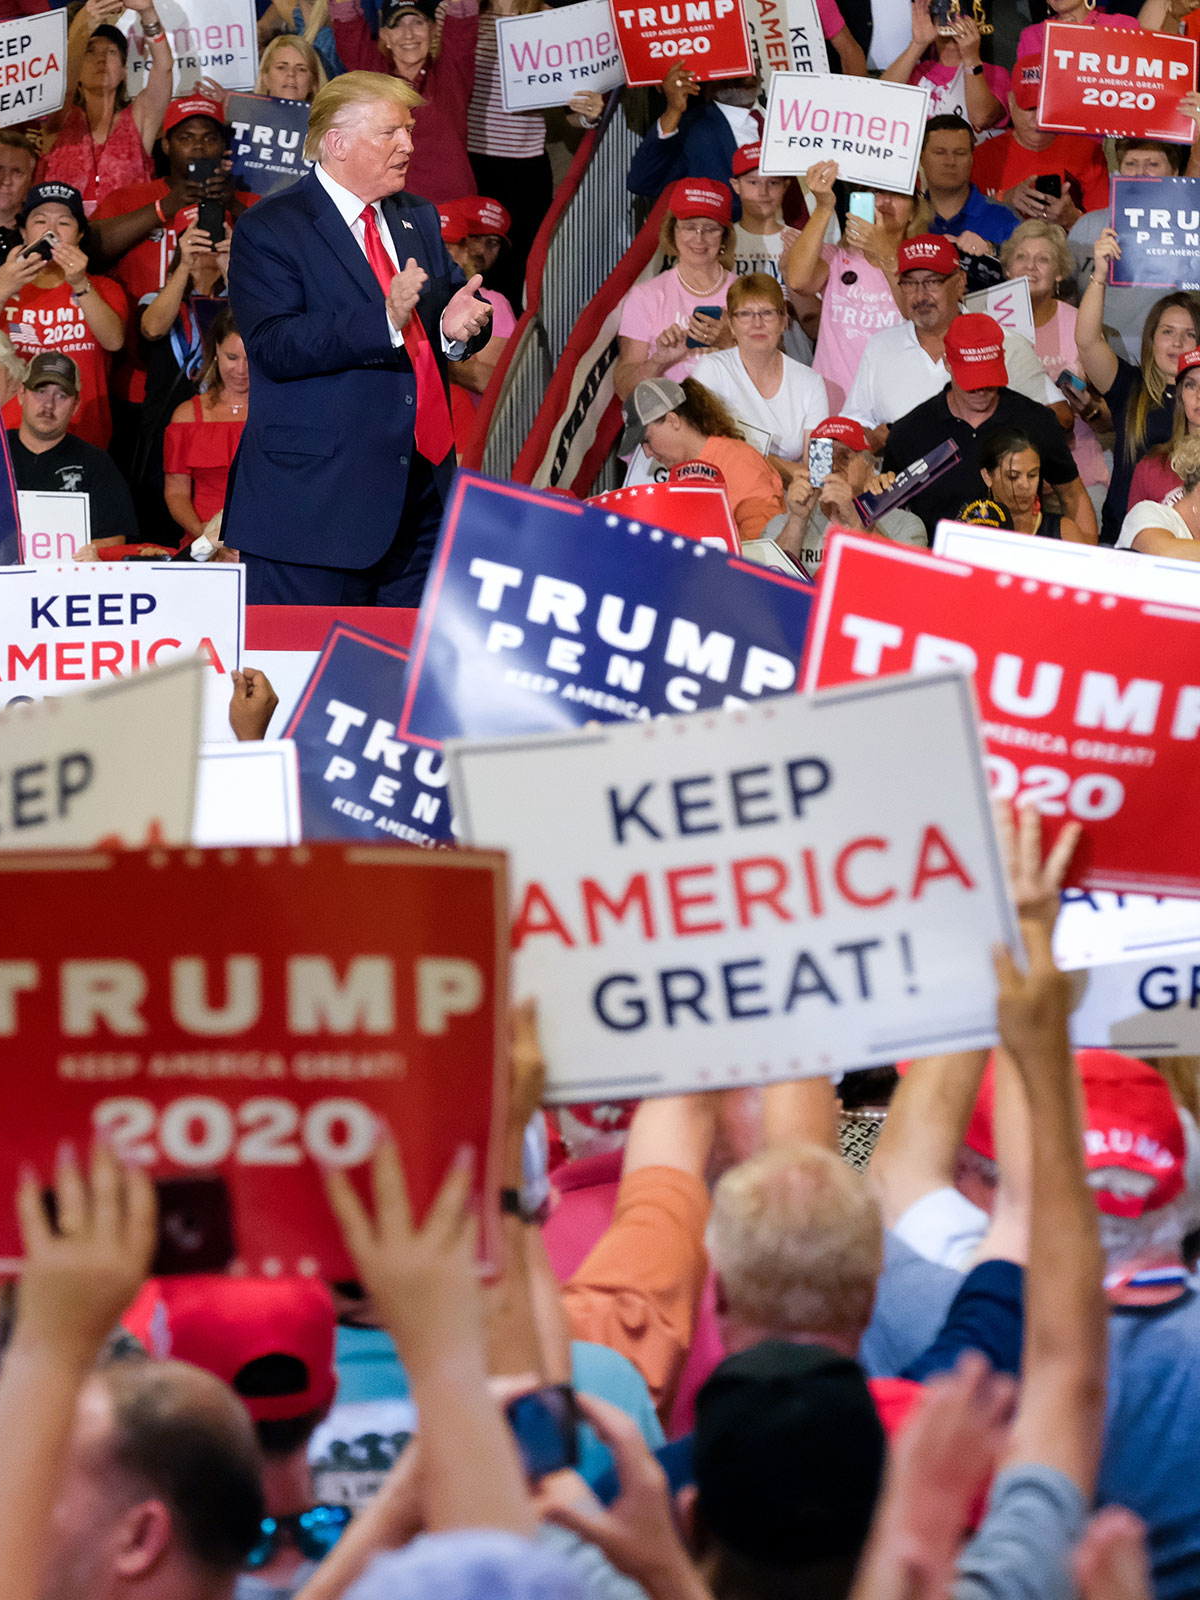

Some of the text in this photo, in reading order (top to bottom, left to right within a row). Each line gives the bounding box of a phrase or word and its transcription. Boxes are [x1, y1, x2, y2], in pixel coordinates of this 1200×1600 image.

[618, 0, 735, 29] TRUMP
[640, 24, 715, 38] KEEP AMERICA GREAT!
[648, 36, 711, 58] 2020
[790, 27, 813, 72] KEE
[133, 53, 235, 73] FO TRUMP
[527, 54, 619, 85] FOR TRUMP
[1053, 49, 1189, 80] TRUMP
[1076, 75, 1165, 91] KEEP AMERICA GREAT!
[1082, 88, 1156, 111] 2020
[231, 121, 300, 149] TRU
[779, 98, 910, 147] Women
[237, 144, 315, 168] PEN
[788, 136, 894, 160] FOR TRUMP
[264, 163, 299, 175] AMERICA
[1124, 208, 1200, 231] TRU
[1136, 231, 1199, 246] PEN
[1146, 248, 1200, 257] KEEP AMERIC
[831, 305, 896, 329] TRUM
[43, 323, 86, 346] 2020
[676, 466, 718, 478] TRUMP
[29, 592, 158, 630] KEEP
[469, 557, 796, 696] TRUMP
[504, 668, 652, 720] KEEP AMERICA
[325, 699, 450, 789] TRU
[983, 718, 1157, 767] MERICA GREAT!
[323, 755, 461, 837] PEN
[606, 756, 835, 846] KEEP
[984, 754, 1126, 820] 020
[331, 796, 375, 823] KEEP
[510, 822, 978, 951] AMERICA
[591, 931, 922, 1035] GREAT!
[57, 1052, 140, 1081] KEEP
[147, 1052, 286, 1081] AMERICA
[94, 1096, 382, 1169] 2020
[1083, 1128, 1175, 1169] RUMP
